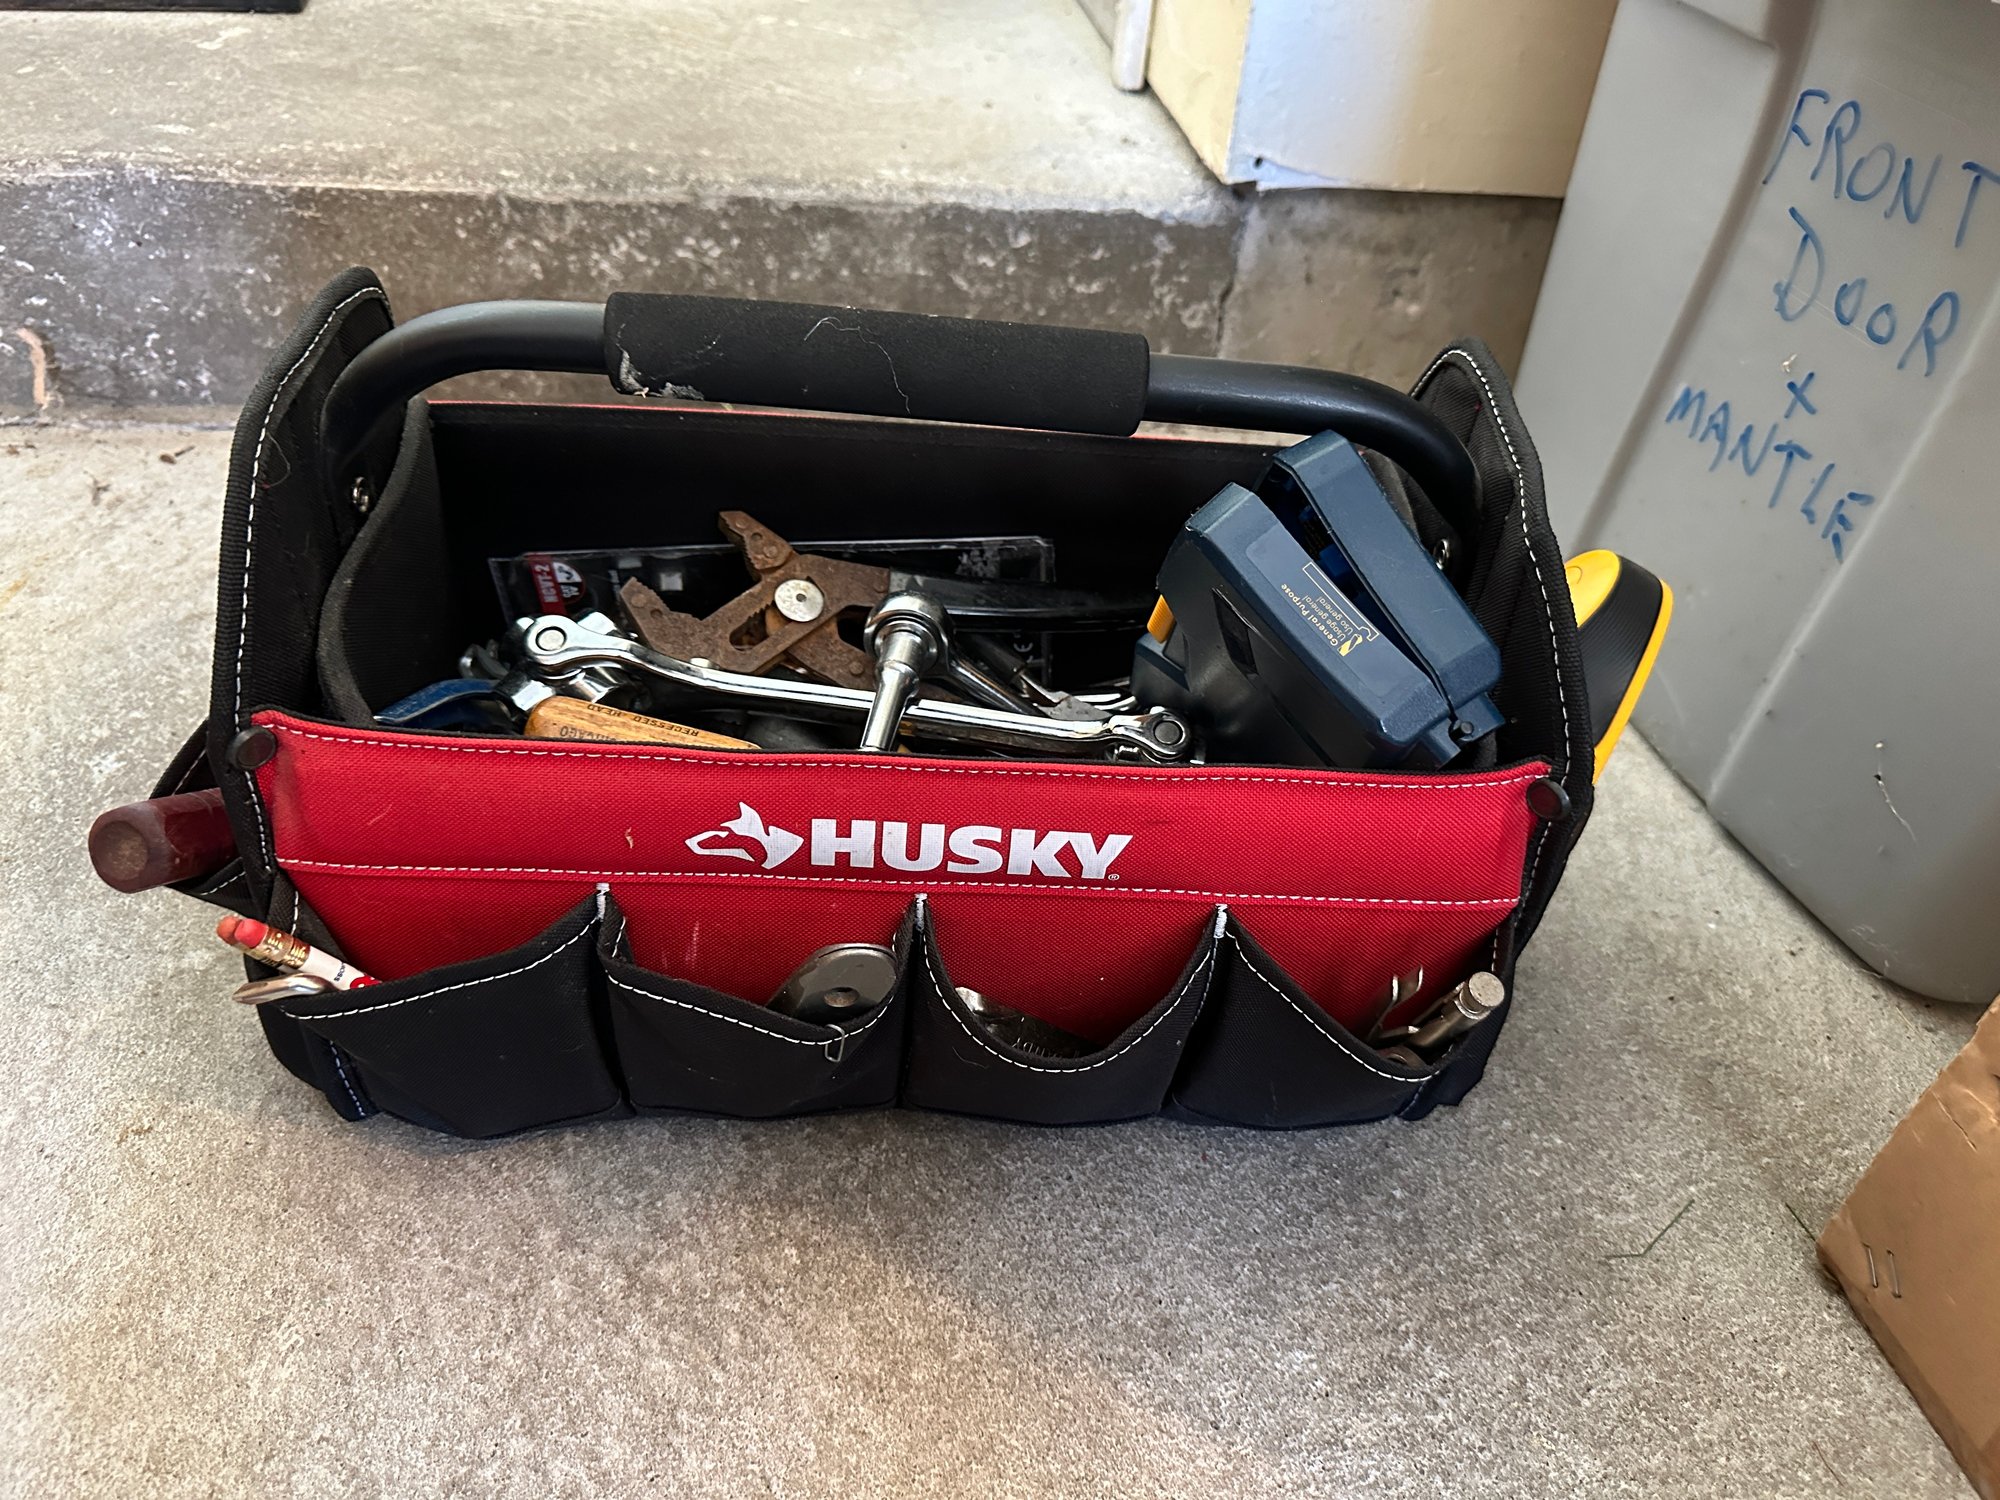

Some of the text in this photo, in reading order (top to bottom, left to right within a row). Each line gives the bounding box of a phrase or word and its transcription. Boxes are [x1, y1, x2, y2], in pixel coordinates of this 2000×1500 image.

[1761, 88, 2000, 248] FRONT
[1665, 384, 1876, 565] MANTLE
[1281, 583, 1338, 646] General Purpose
[1315, 596, 1353, 636] Uso general
[1326, 618, 1346, 642] Usage
[587, 703, 699, 737] RECESSED HEAD
[811, 818, 1133, 878] HUSKY
